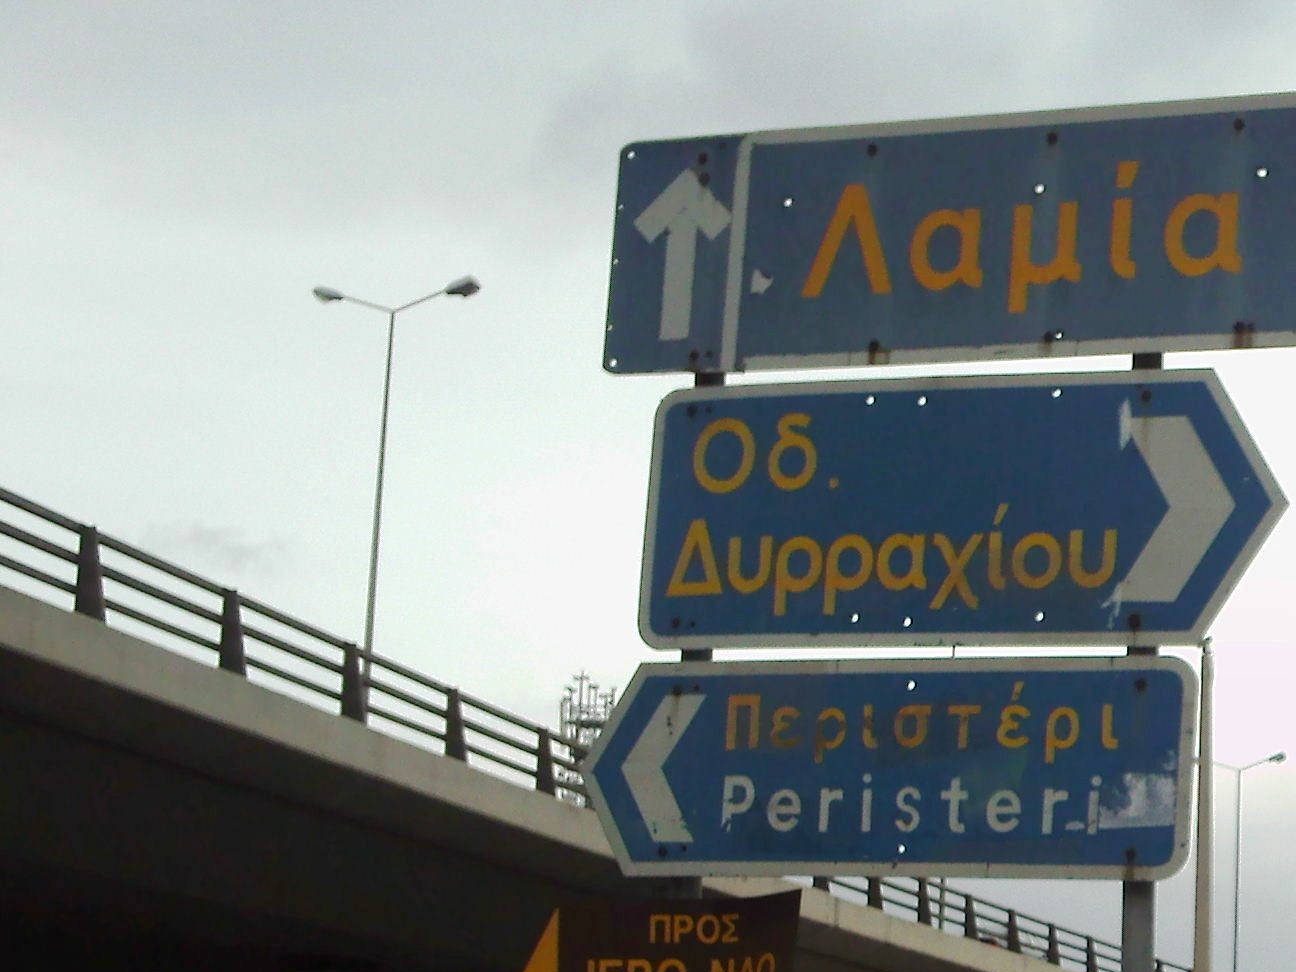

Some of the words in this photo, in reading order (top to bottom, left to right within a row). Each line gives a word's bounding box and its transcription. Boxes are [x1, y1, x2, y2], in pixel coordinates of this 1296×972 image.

[801, 160, 1243, 314] Λαμία
[692, 412, 839, 494] Οδ.
[666, 503, 1118, 616] Δυρραχίου
[725, 682, 1119, 763] Περιστέρι
[720, 774, 1103, 836] Peristeri
[649, 913, 740, 945] ΠΡΟΣ
